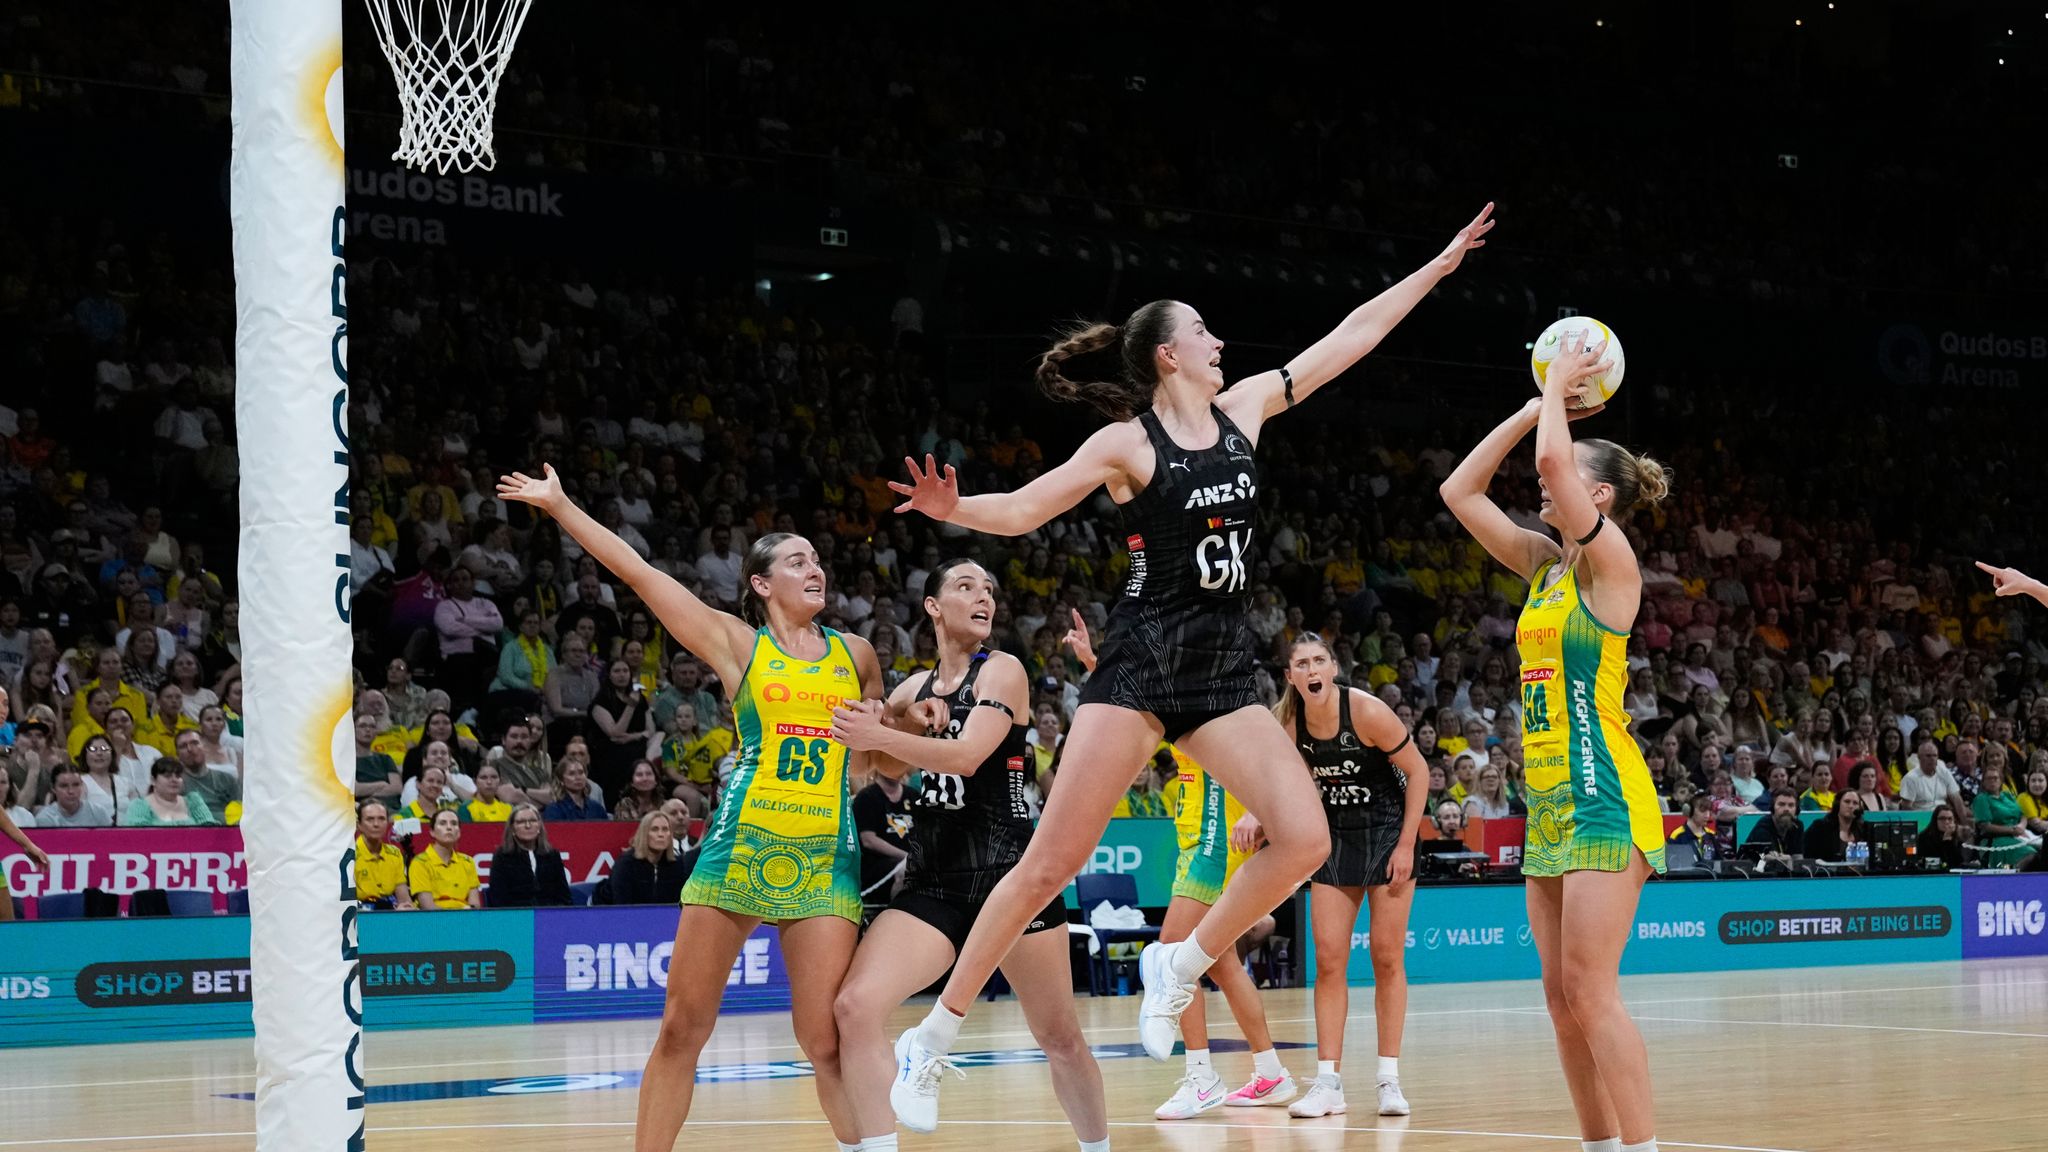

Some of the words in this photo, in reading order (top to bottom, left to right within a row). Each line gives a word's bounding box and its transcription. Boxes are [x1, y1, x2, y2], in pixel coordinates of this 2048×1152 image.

[346, 165, 457, 205] udos
[463, 175, 565, 217] Bank
[346, 210, 447, 246] rena
[1939, 330, 2027, 358] Qudos
[1941, 361, 2020, 388] Arena
[1184, 482, 1235, 509] ANZ
[1196, 528, 1252, 592] GK
[1523, 627, 1557, 645] origin
[796, 691, 857, 712] origi
[1573, 680, 1591, 735] FLIGHT
[776, 737, 829, 785] GS
[1581, 736, 1598, 797] CENTRE
[751, 798, 833, 818] MELBOURNE
[1208, 778, 1219, 818] FLIGHT
[1638, 921, 1706, 939] BRANDS
[1728, 919, 1775, 938] SHOP
[1779, 917, 1842, 936] BETTER
[1846, 916, 1867, 933] AT
[1871, 914, 1909, 932] BING
[1914, 914, 1943, 930] LEE
[1977, 900, 2045, 937] BING
[1446, 928, 1504, 945] VALUE
[95, 972, 184, 998] SHOP
[366, 962, 437, 986] BING
[446, 961, 497, 984] LEE
